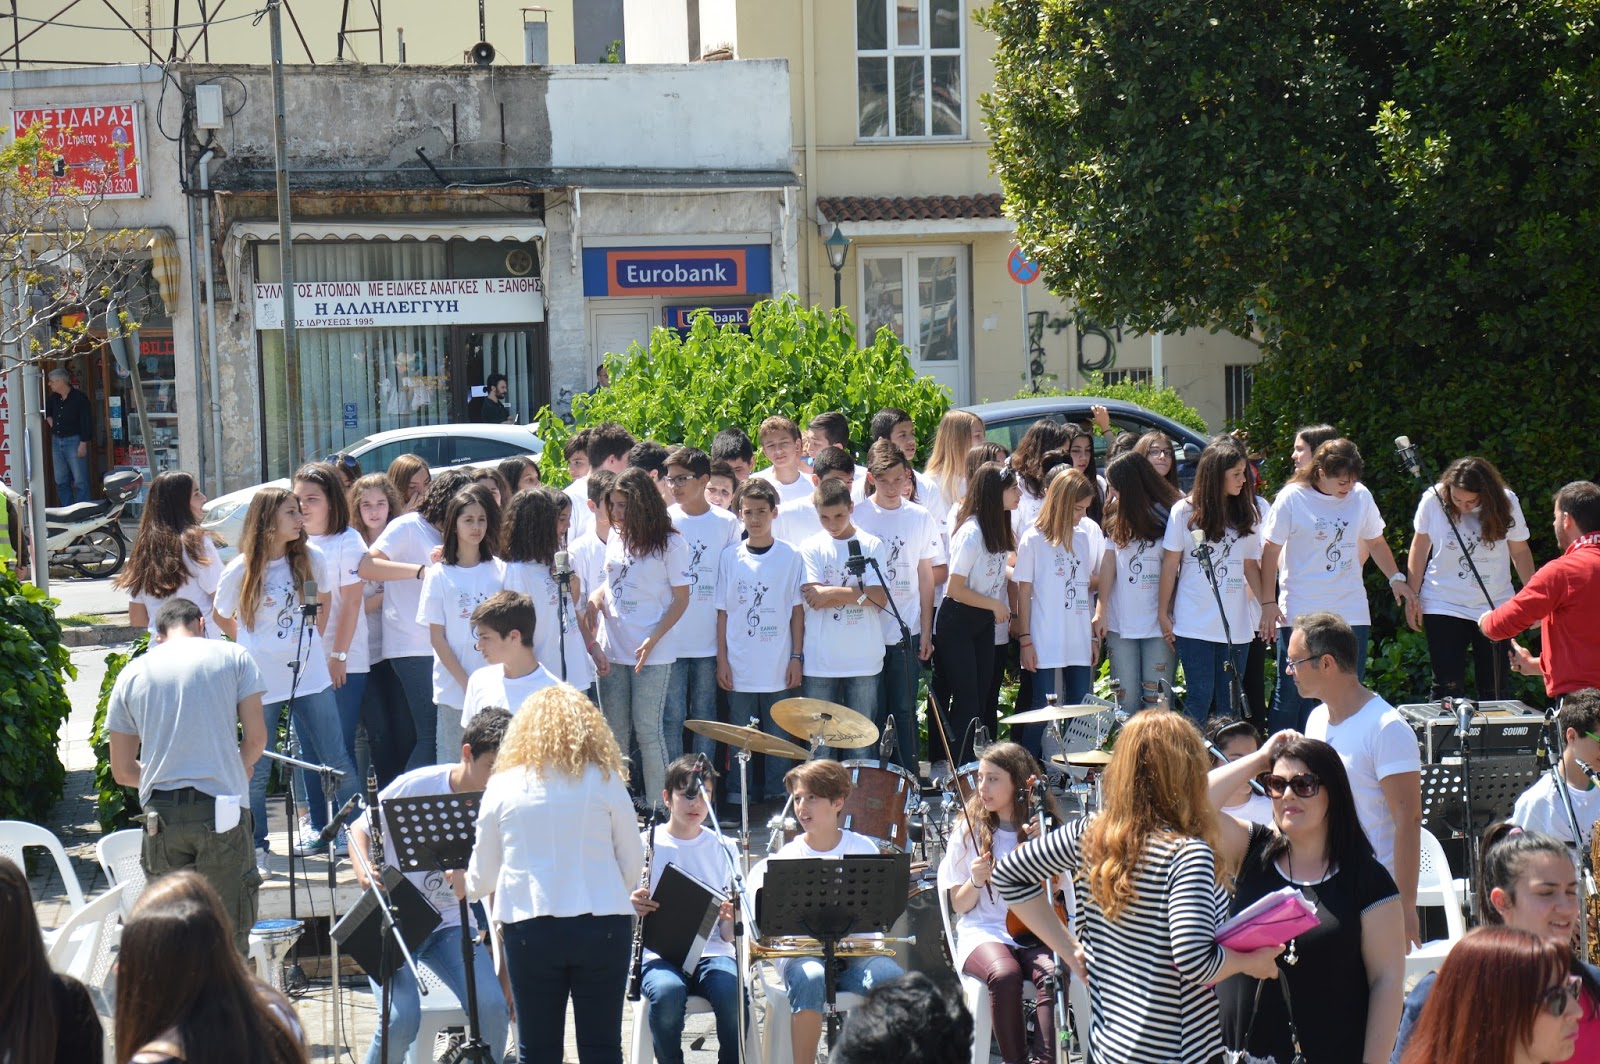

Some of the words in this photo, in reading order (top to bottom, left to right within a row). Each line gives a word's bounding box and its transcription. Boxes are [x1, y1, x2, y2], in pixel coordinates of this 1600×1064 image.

[16, 105, 132, 131] ΚΛΕΙΔΑΡΑΣ
[114, 178, 133, 193] 2300
[626, 263, 728, 284] Eurobank
[257, 284, 313, 299] ΣΥΛΛΟΣ
[315, 283, 361, 298] ΑΤΟΜΩΝ
[368, 282, 384, 297] ΜΕ
[387, 281, 427, 297] ΕΙΔΙΚΕΣ
[429, 280, 479, 296] ΑΝΑΓΚΕΣ
[485, 279, 496, 294] Ν.
[498, 278, 542, 294] ΞΑΝΘΗΣ
[315, 302, 328, 316] Η
[333, 300, 459, 316] ΑΛΛΗΛΕΓΓΥΗ
[306, 318, 352, 328] ΙΔΡΥΣΕΩΣ
[354, 317, 374, 326] 1995
[1502, 726, 1529, 737] SOUND
